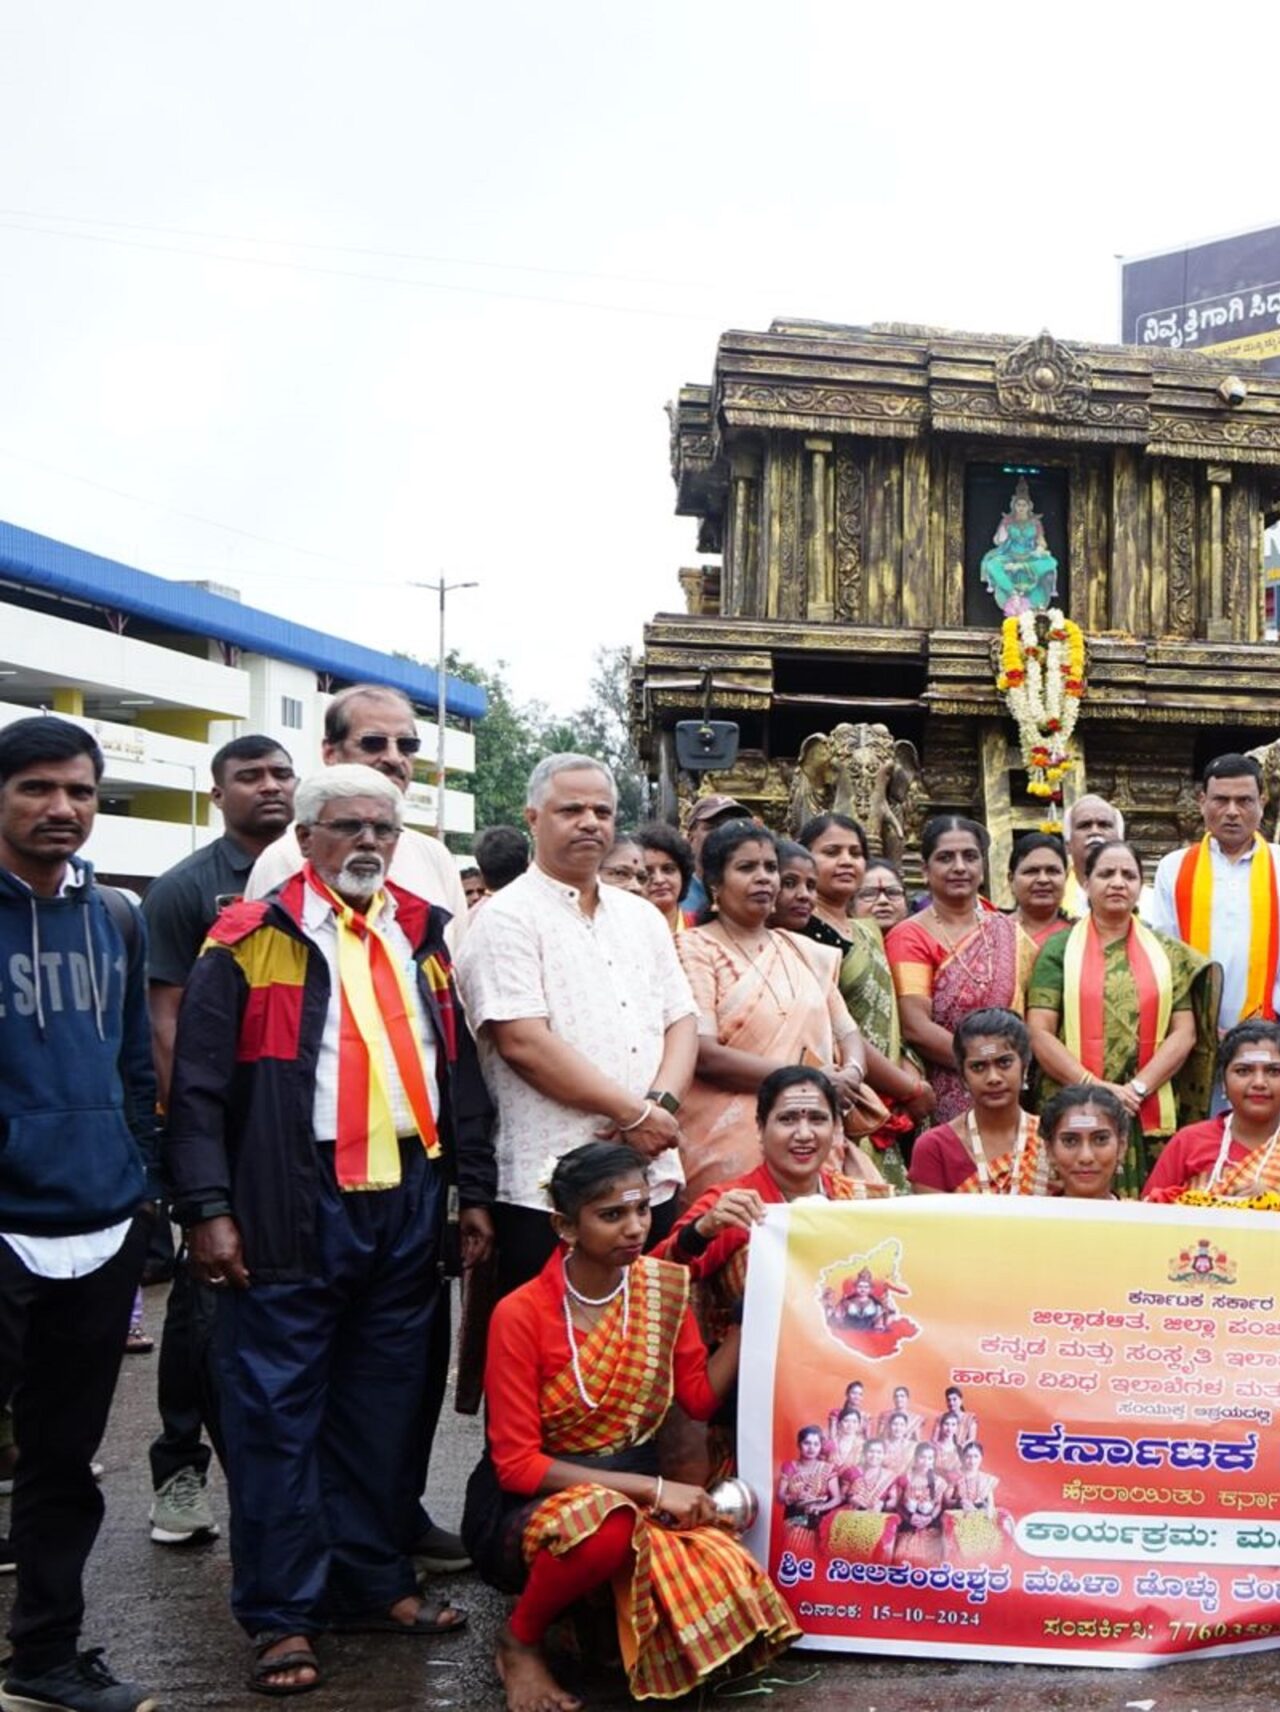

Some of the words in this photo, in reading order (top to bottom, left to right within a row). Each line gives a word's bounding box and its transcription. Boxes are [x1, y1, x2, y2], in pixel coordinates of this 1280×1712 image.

[1144, 297, 1244, 348] ನಿವೃತ್ತಿಗಾಗಿ
[1129, 1290, 1204, 1307] ಕರ್ನಾಟಕ
[1212, 1297, 1275, 1311] ಸರ್ಕಾರ
[1163, 1317, 1216, 1338] ಜಿಲ್ಲಾ
[981, 1337, 1047, 1362] ಕನ್ನಡ
[1059, 1341, 1113, 1364] ಮತ್ತು
[1127, 1344, 1212, 1373] ಸಂಸ್ಕೃತಿ
[953, 1368, 1025, 1387] ಹಾಗೂ
[1040, 1372, 1098, 1393] ವಿವಿಧ
[1112, 1376, 1223, 1397] ಇಲಾಖೆಗಳ
[1119, 1401, 1186, 1419] ಸಂಯುಕ್ತ
[1019, 1425, 1257, 1471] ಕರ್ನಾಟಕ
[1062, 1478, 1205, 1504] ಹೆಸರಾಯಿತು
[1025, 1519, 1217, 1552] ಕಾರ್ಯಕ್ರಮ:
[779, 1553, 813, 1585] ಶ್ರೀ
[1025, 1569, 1119, 1595] ಮಹಿಳಾ
[1136, 1571, 1218, 1612] ಡೊಳ್ಳು
[799, 1602, 861, 1618] ದಿನಾಂಕ:
[872, 1605, 980, 1626] 15-10-2024
[1044, 1617, 1153, 1640] ಸಂಪರ್ಕಿಸಿ:
